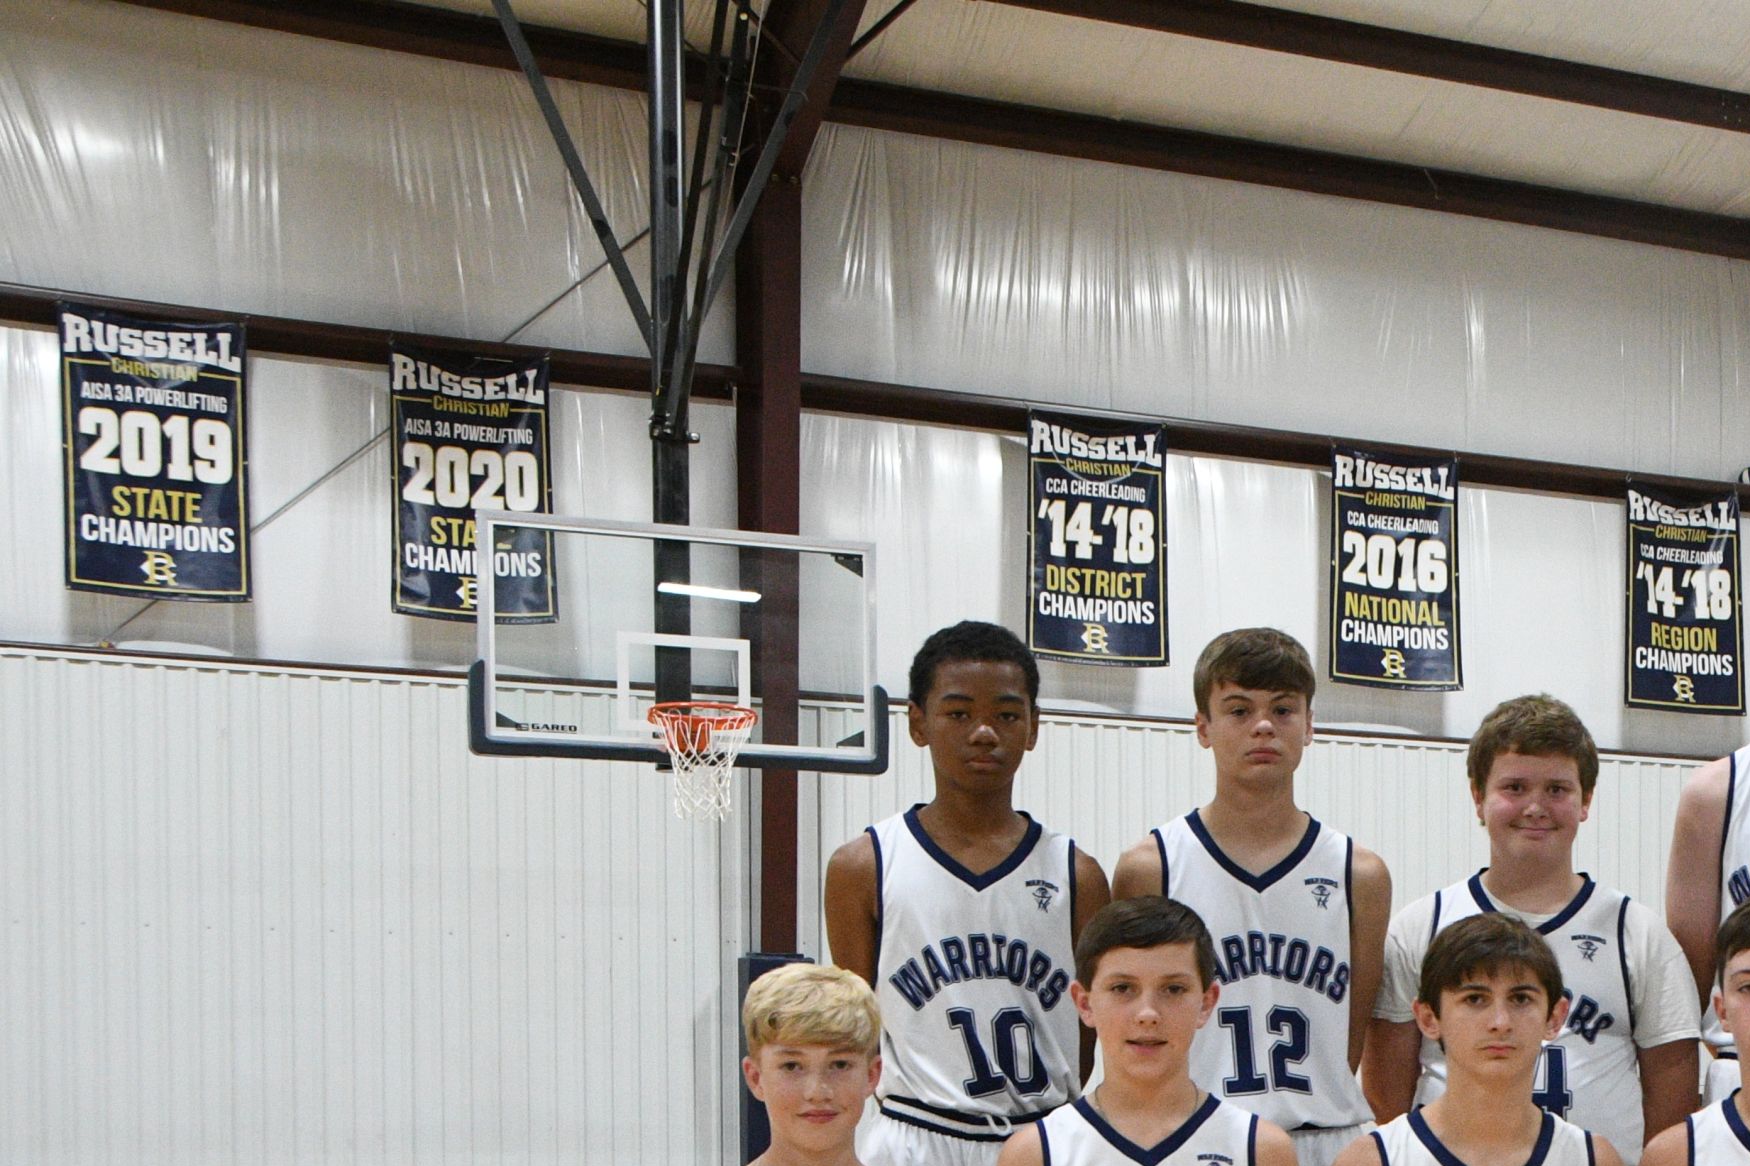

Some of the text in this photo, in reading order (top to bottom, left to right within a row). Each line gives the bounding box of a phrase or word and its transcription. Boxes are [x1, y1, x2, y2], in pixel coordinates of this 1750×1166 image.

[62, 313, 241, 373] RUSSELL
[111, 357, 198, 381] CHRISTIAN
[392, 353, 545, 405] RUSSELL
[80, 381, 228, 414] AISA 3A POWERLIFTING
[433, 396, 510, 418] CHRISTIAN
[79, 406, 233, 485] 2019
[405, 418, 533, 445] AISA 3A POWERLIFTING
[1031, 418, 1162, 468] RUSSELL
[403, 442, 539, 512] 2020
[1066, 457, 1132, 476] CHRISTIAN
[1334, 453, 1455, 500] RUSSELL
[112, 486, 203, 523] STATE
[1046, 477, 1146, 504] CCA CHEERLEADING
[1365, 491, 1426, 511] CHRISTIAN
[1347, 510, 1439, 535] CCA CHEERLEADING
[1627, 489, 1736, 531] RUSSELL
[80, 513, 235, 554] CHAMPIONS
[431, 516, 512, 550] STA
[1655, 524, 1707, 544] CHRISTIAN
[405, 543, 542, 578] CHAMONS
[1342, 530, 1448, 594] 2016
[1640, 543, 1724, 565] CCA CHEERLEADING
[1046, 564, 1146, 599] DISTRICT
[1039, 591, 1155, 625] CHAMPIONS
[1344, 591, 1445, 627] NATIONAL
[1340, 618, 1449, 650] CHAMPIONS
[1651, 622, 1717, 653] REGION
[1635, 646, 1734, 677] CHAMPIONS
[531, 723, 578, 732] GARED
[888, 933, 1070, 1012] WARRIORS
[946, 1006, 1051, 1098] 10
[1218, 1005, 1313, 1097] 12
